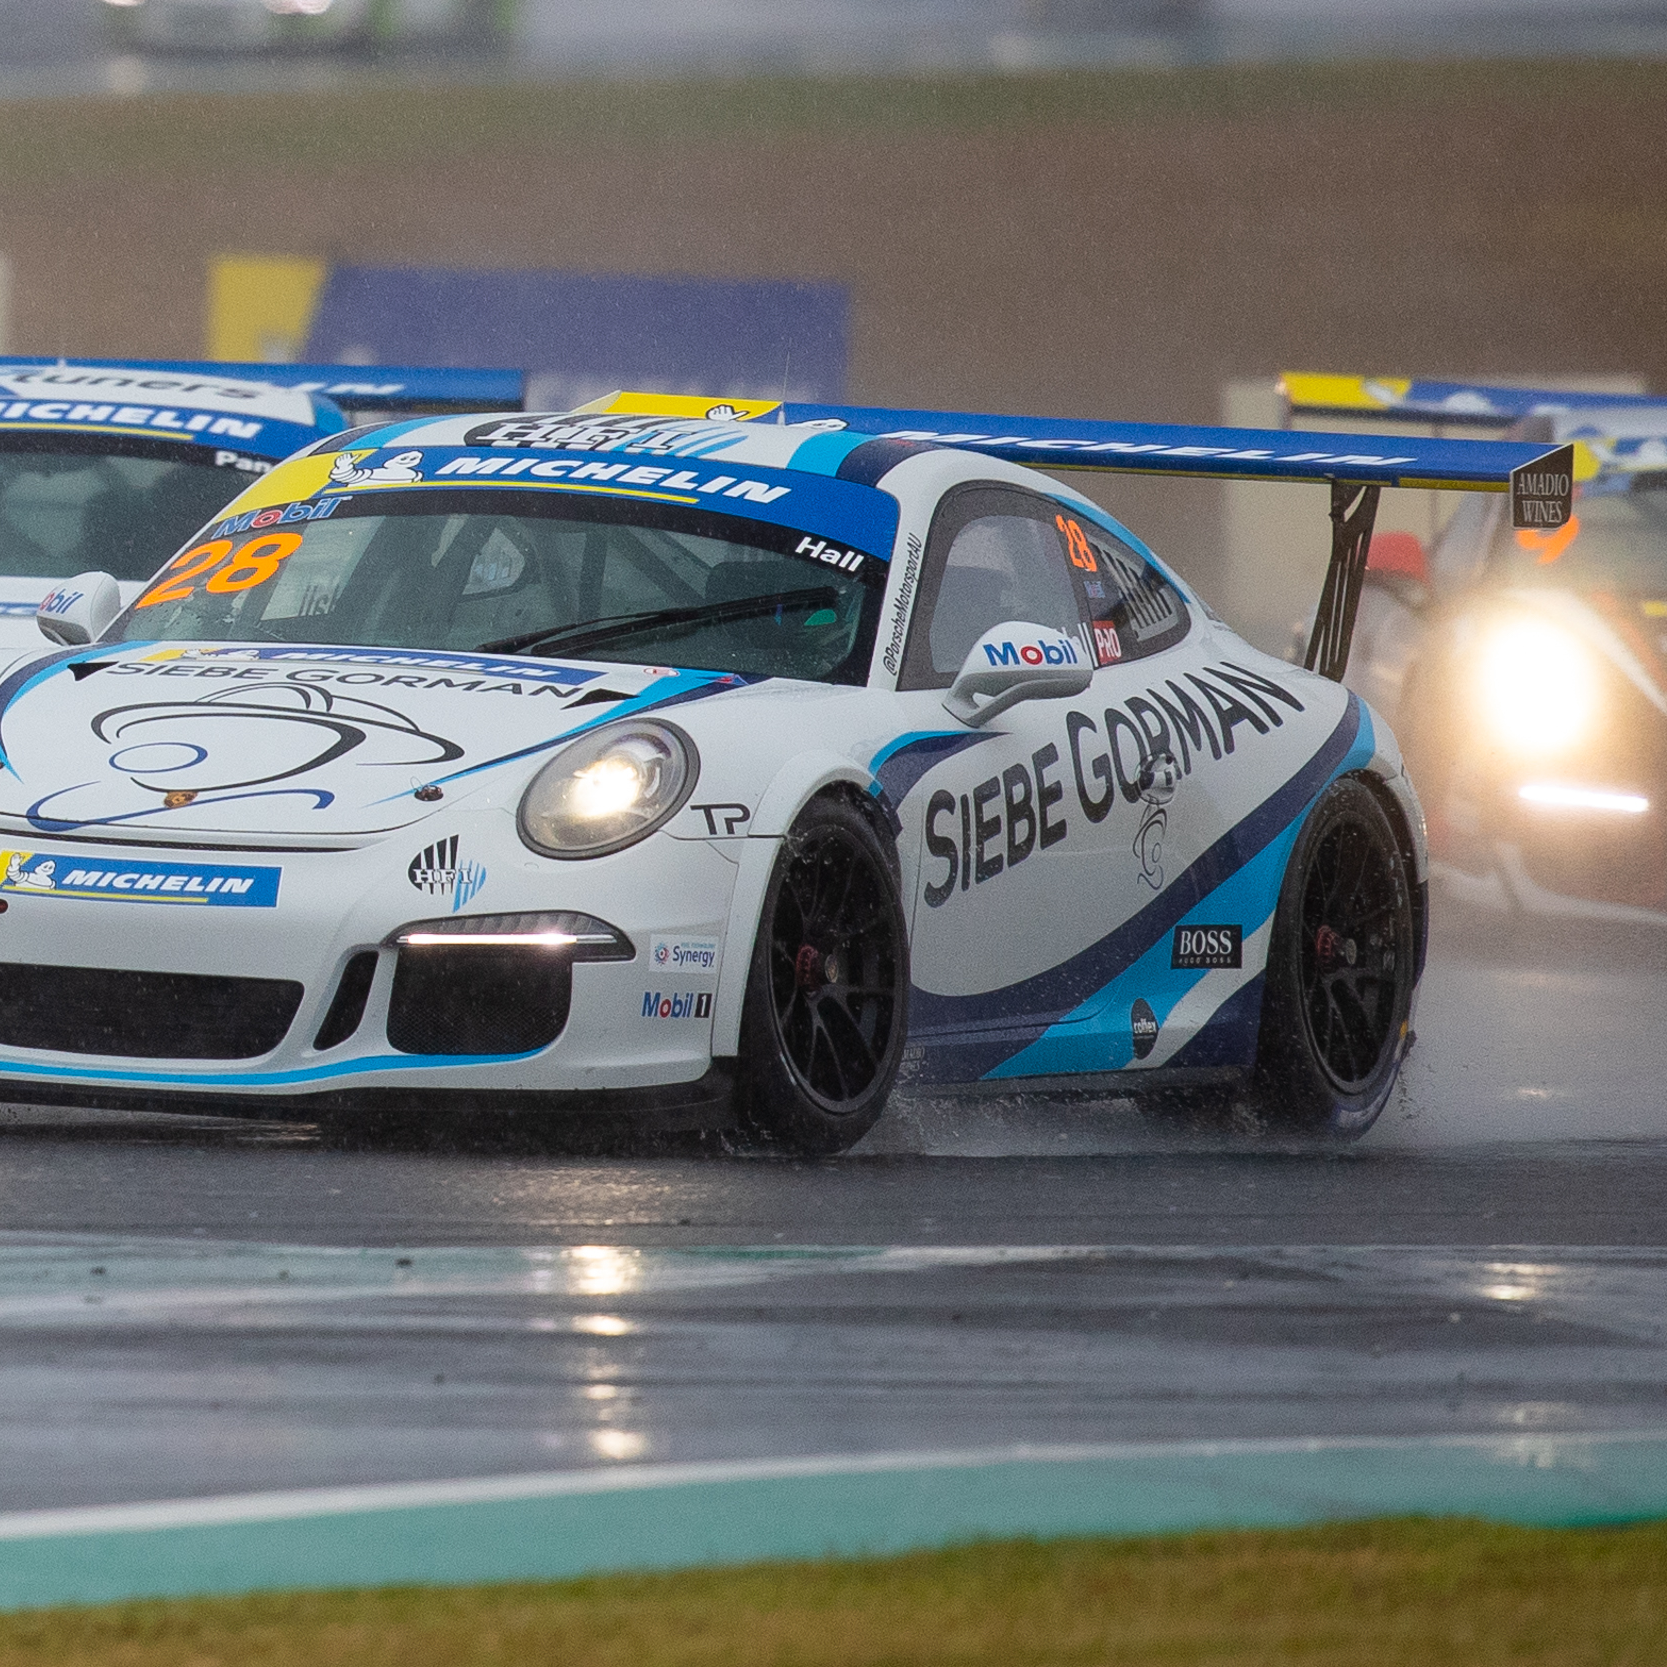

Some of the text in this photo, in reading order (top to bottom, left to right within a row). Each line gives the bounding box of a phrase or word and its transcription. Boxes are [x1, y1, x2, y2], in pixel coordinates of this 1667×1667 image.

[16, 371, 263, 400] tuners
[475, 422, 701, 451] HFI
[877, 430, 1418, 466] MICHELIN
[435, 457, 791, 504] MICHELIN
[1517, 473, 1569, 496] AMADIO
[211, 496, 353, 540] Mobil
[1522, 500, 1564, 523] WINES
[795, 536, 864, 572] Hall
[1055, 514, 1097, 572] 28
[135, 532, 303, 610] 28
[40, 588, 85, 614] obil
[883, 533, 923, 676] @PorscheMotorsportAU
[984, 639, 1077, 666] Mobil
[1094, 628, 1121, 658] PRO
[270, 651, 562, 677] MICHELIN
[107, 662, 584, 698] SIEBE GORMAN
[924, 661, 1305, 908] SIEBE GORMAN
[61, 869, 256, 894] MICHELIN
[412, 868, 473, 884] HFI
[673, 945, 715, 967] Synergy
[1179, 930, 1232, 955] BOSS
[641, 992, 693, 1018] Mobil
